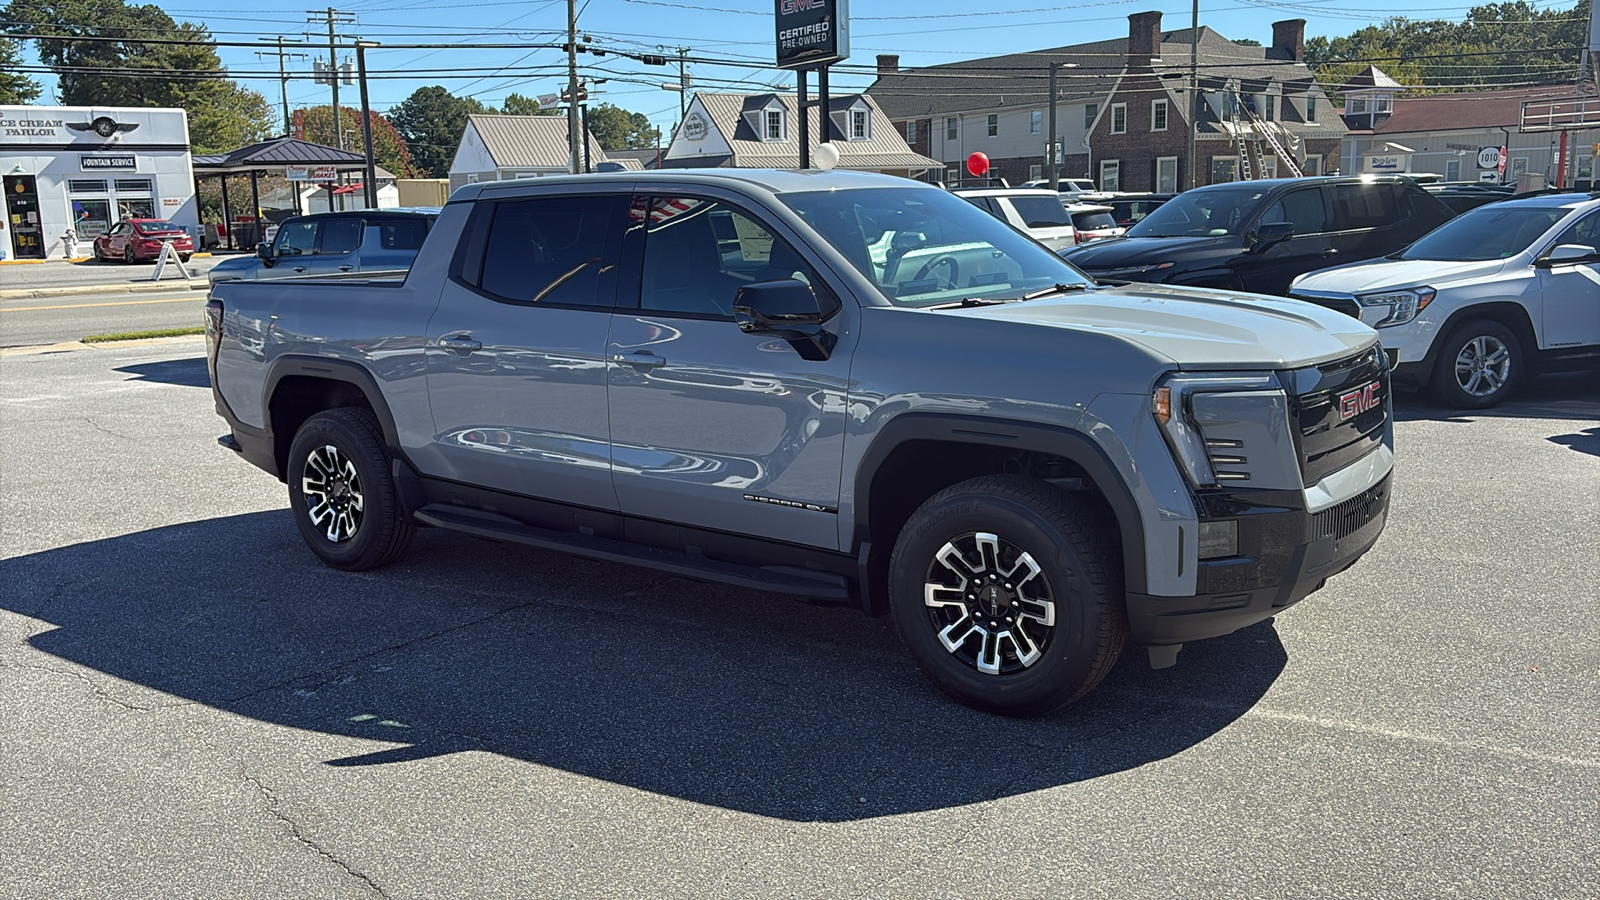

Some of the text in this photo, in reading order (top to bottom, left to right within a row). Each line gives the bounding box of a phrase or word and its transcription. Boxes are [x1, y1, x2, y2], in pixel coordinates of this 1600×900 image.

[780, 22, 829, 40] CERTIFIED
[782, 33, 827, 49] PRE-OWNED
[83, 158, 134, 166] FOUNTAIN SERVICE
[1481, 153, 1498, 163] 1010
[1340, 380, 1380, 420] GMC
[744, 495, 803, 507] SIERRA
